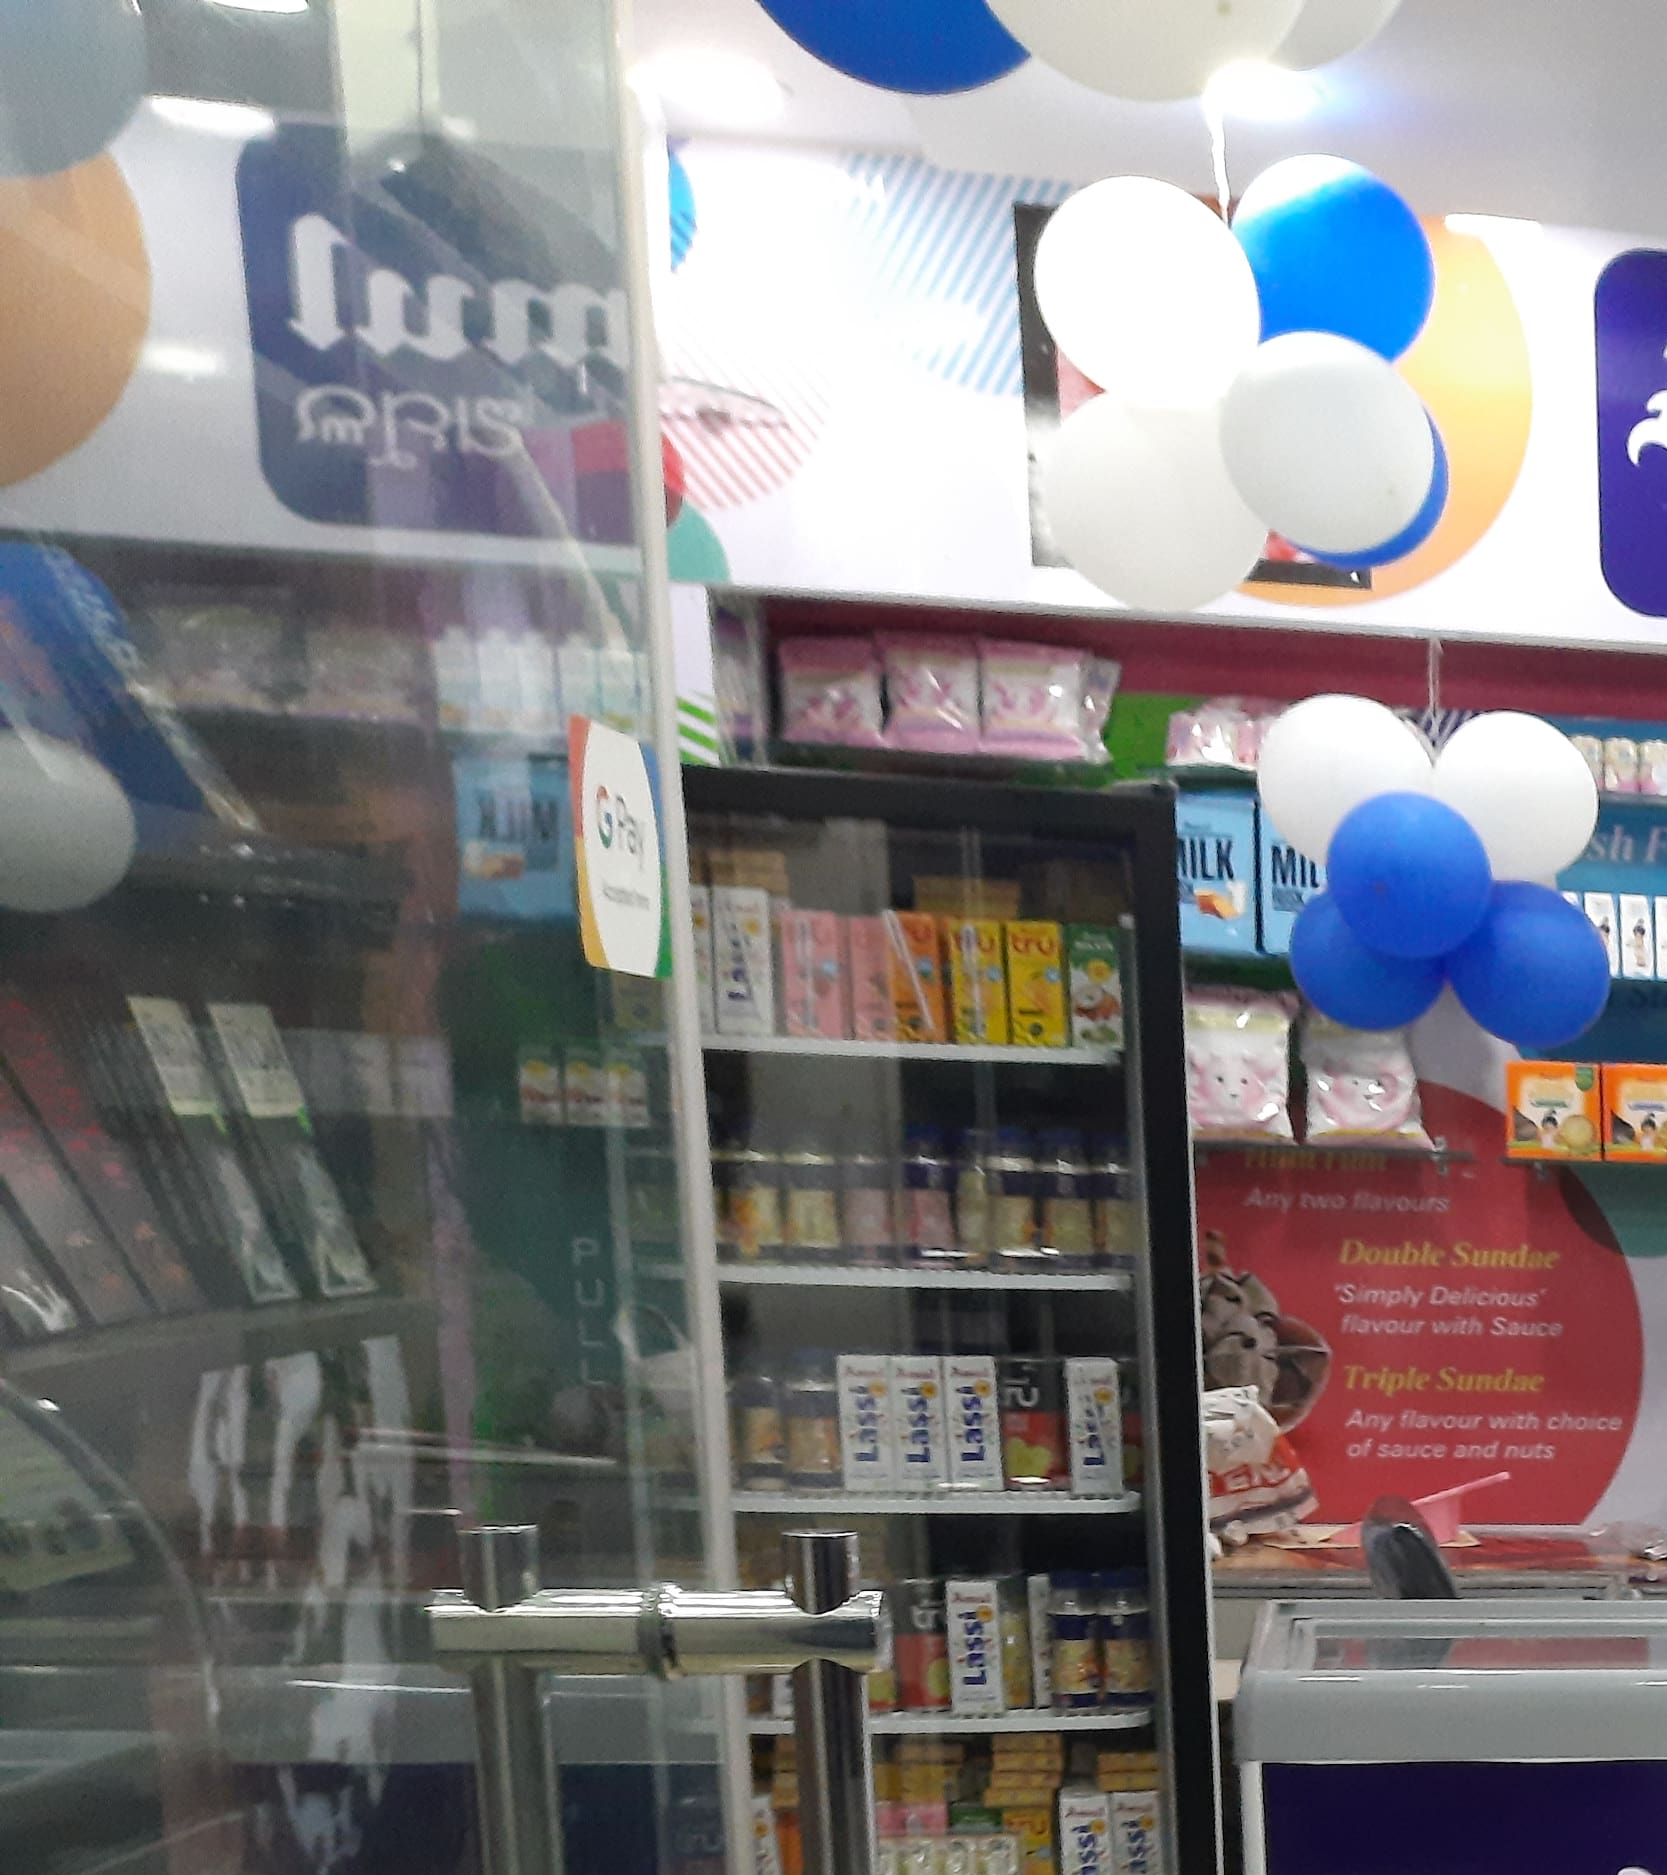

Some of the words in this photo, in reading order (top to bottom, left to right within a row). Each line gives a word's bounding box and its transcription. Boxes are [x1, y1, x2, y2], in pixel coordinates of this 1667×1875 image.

[1271, 844, 1321, 888] MIL
[1299, 1192, 1345, 1210] two
[1352, 1189, 1451, 1213] flavours
[1340, 1239, 1446, 1267] Double
[1451, 1240, 1561, 1270] Sundae
[572, 1236, 606, 1386] PULL
[1341, 1314, 1425, 1336] flavour
[1431, 1315, 1484, 1336] with
[1490, 1316, 1564, 1338] Sauce
[1344, 1365, 1431, 1397] Triple
[1436, 1366, 1545, 1393] Sundae
[1345, 1408, 1393, 1433] Any
[1400, 1409, 1484, 1430] flavour
[1488, 1410, 1540, 1431] with
[1545, 1411, 1624, 1432] choice
[1346, 1438, 1373, 1459] of
[1377, 1442, 1447, 1459] sauce
[1453, 1440, 1499, 1460] and
[1503, 1441, 1557, 1460] nuts
[957, 1609, 988, 1686] Lassi
